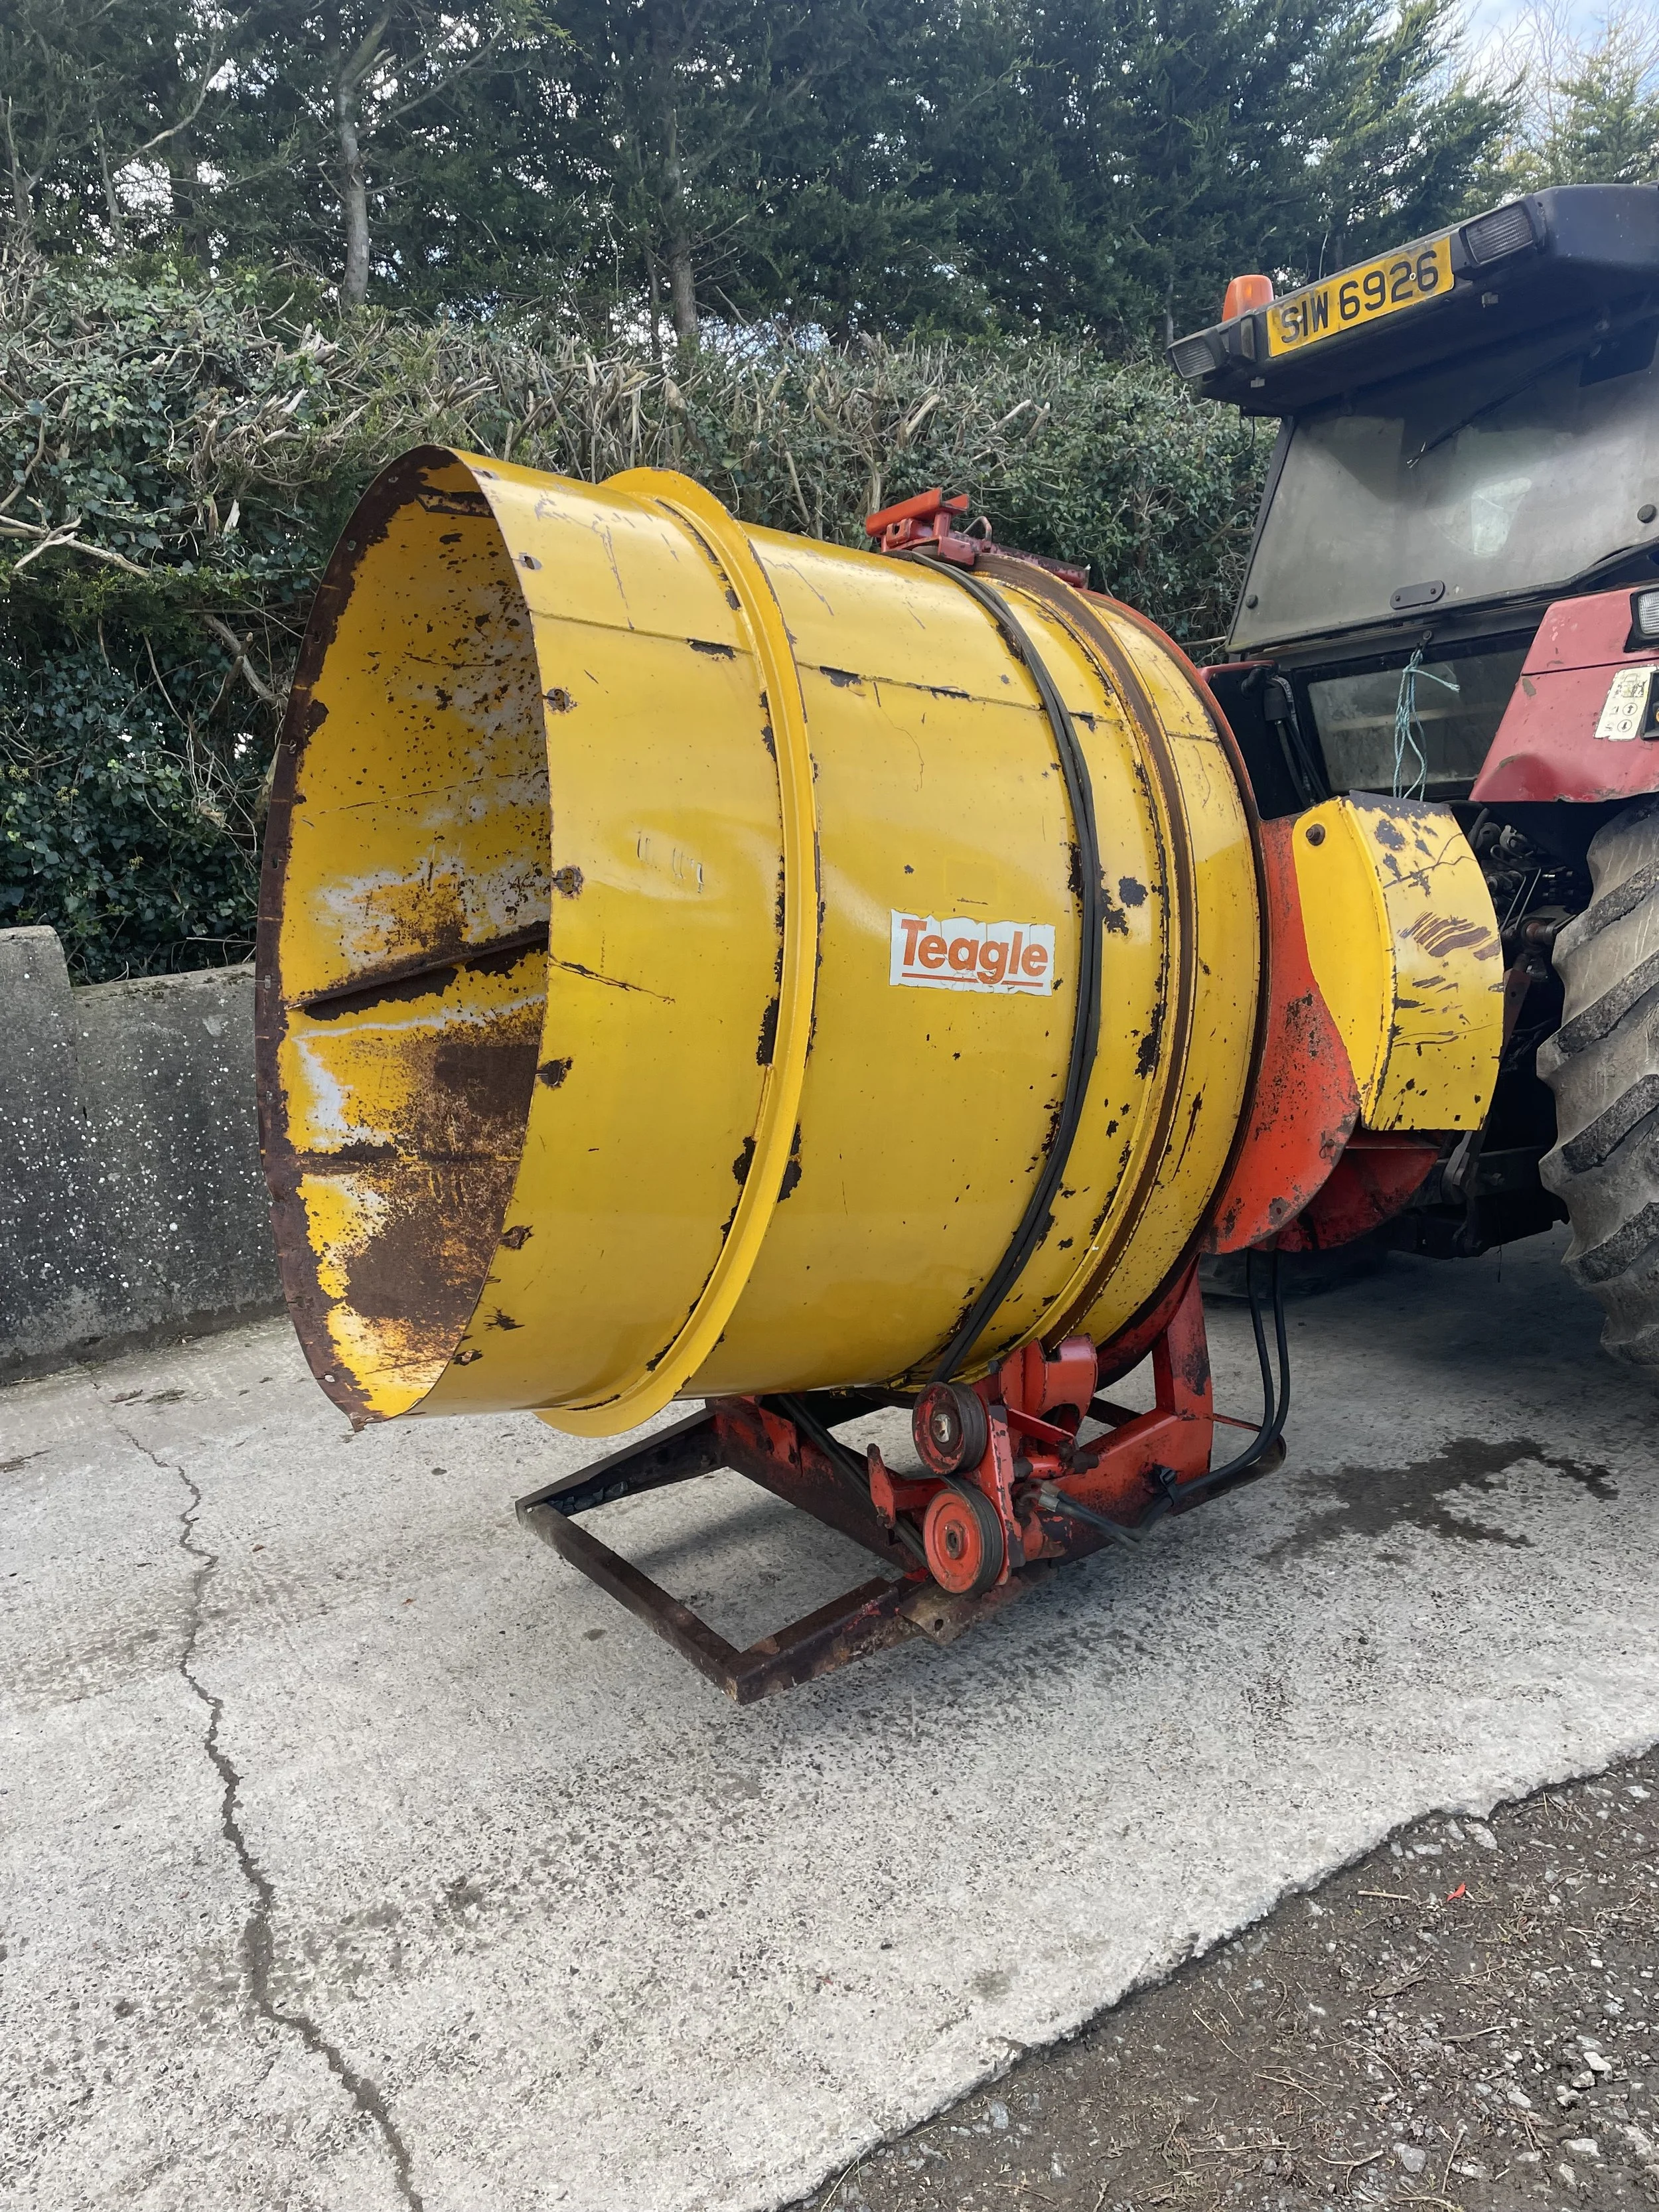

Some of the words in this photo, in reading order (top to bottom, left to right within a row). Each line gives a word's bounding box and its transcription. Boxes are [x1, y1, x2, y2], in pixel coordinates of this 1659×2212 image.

[1281, 291, 1328, 343] SIW
[1339, 250, 1439, 321] 6926
[901, 919, 1048, 985] Teagle
